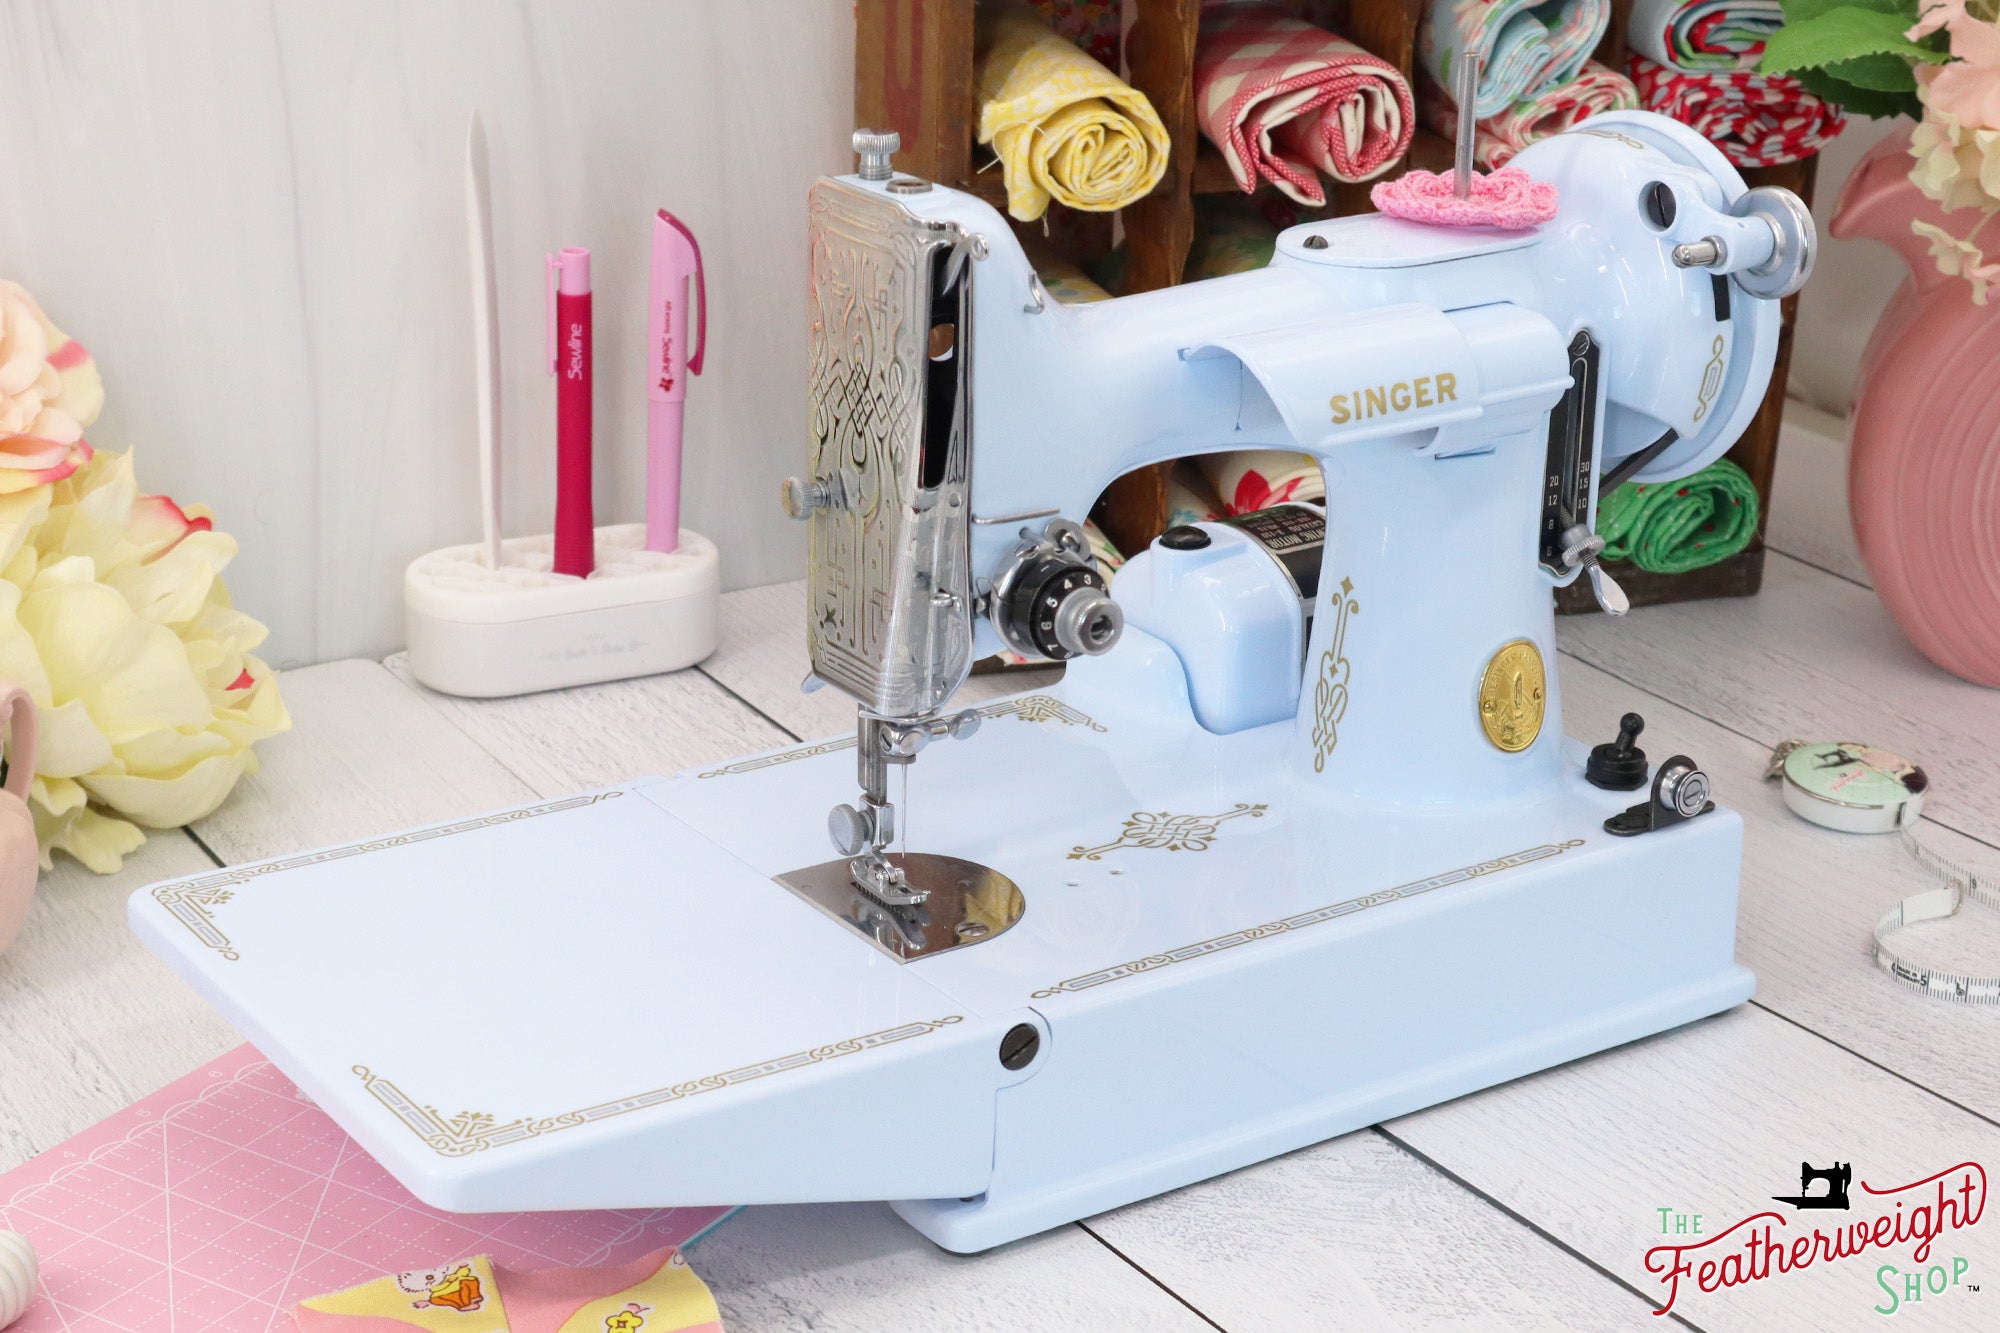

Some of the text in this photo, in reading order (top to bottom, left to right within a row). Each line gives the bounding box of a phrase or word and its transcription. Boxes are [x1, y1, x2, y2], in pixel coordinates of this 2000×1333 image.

[568, 322, 583, 380] Sewline
[1329, 372, 1457, 425] SINGER
[1580, 461, 1590, 472] 30
[1549, 476, 1559, 487] 20
[1579, 478, 1588, 489] 15
[1548, 495, 1558, 506] 12
[1577, 498, 1587, 509] 10
[1548, 519, 1554, 530] 8
[1266, 532, 1302, 548] MOTOR
[1546, 545, 1552, 556] 6
[1063, 578, 1073, 590] 4
[1083, 574, 1092, 585] 3
[1046, 597, 1058, 608] 5
[1040, 621, 1052, 630] 6
[1047, 644, 1058, 652] 7
[1920, 975, 1927, 986] 5
[1956, 982, 1965, 996] 6
